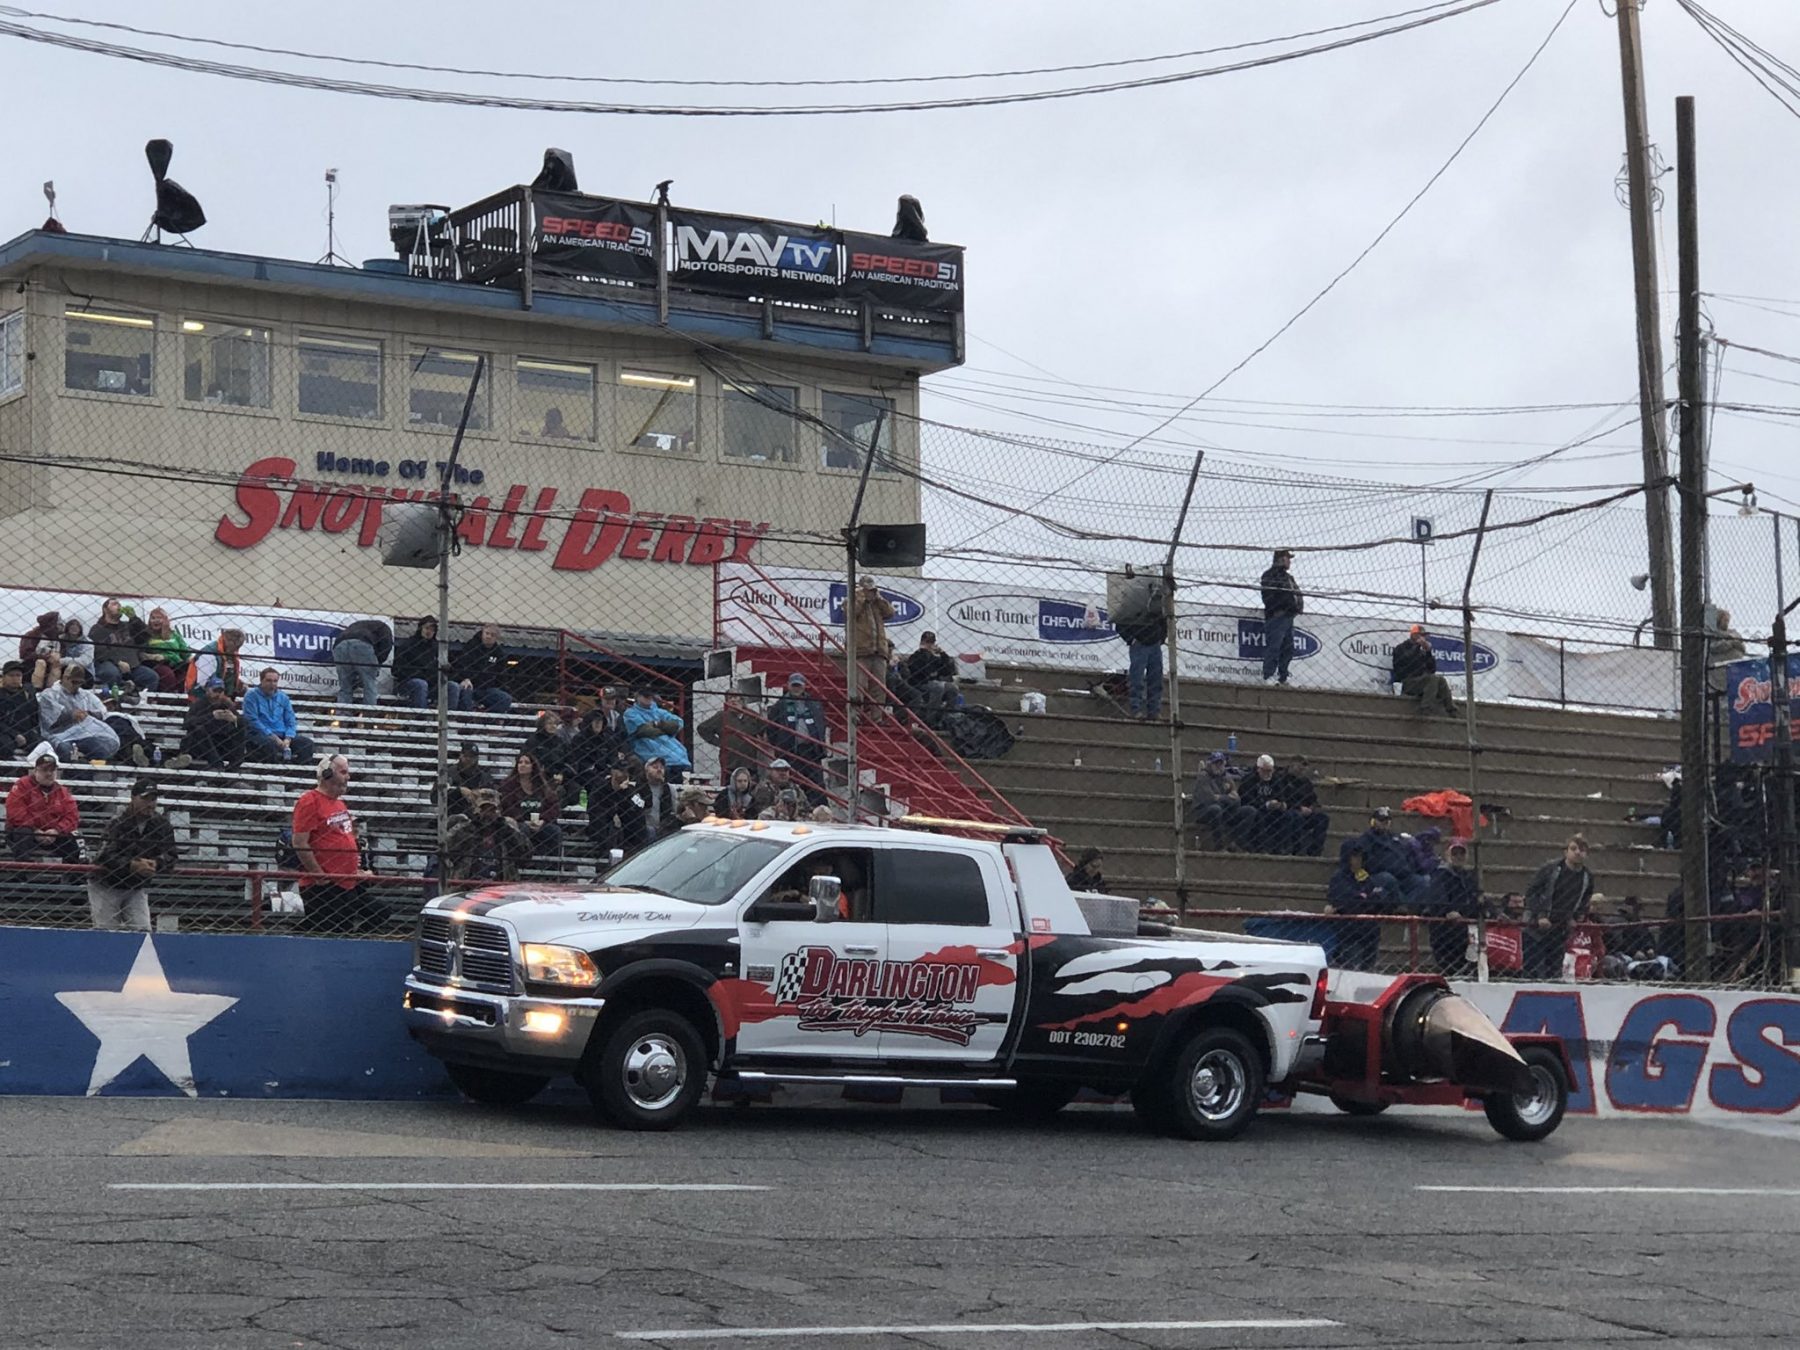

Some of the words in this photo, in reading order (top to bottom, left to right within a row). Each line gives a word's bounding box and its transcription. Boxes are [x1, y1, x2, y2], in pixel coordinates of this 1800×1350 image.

[542, 234, 557, 244] AN
[558, 236, 605, 249] AMERICAN
[680, 260, 779, 278] MOTORSPORTS
[781, 268, 836, 285] NETWORK
[850, 270, 865, 280] AN
[866, 271, 913, 286] AMERICAN
[913, 277, 959, 291] TRADITION
[316, 450, 391, 477] Home
[398, 459, 428, 480] Of
[435, 461, 485, 485] The
[551, 488, 770, 571] DERBY
[1415, 518, 1432, 542] D
[956, 605, 991, 622] Allen
[994, 608, 1036, 626] Turner
[278, 632, 338, 652] HYUN
[1349, 639, 1378, 655] Allen
[576, 910, 640, 924] Darlington
[644, 910, 672, 922] Dan
[798, 946, 981, 1003] DARLINGTON
[1049, 1030, 1073, 1044] DOT
[1073, 1031, 1126, 1049] 2302782
